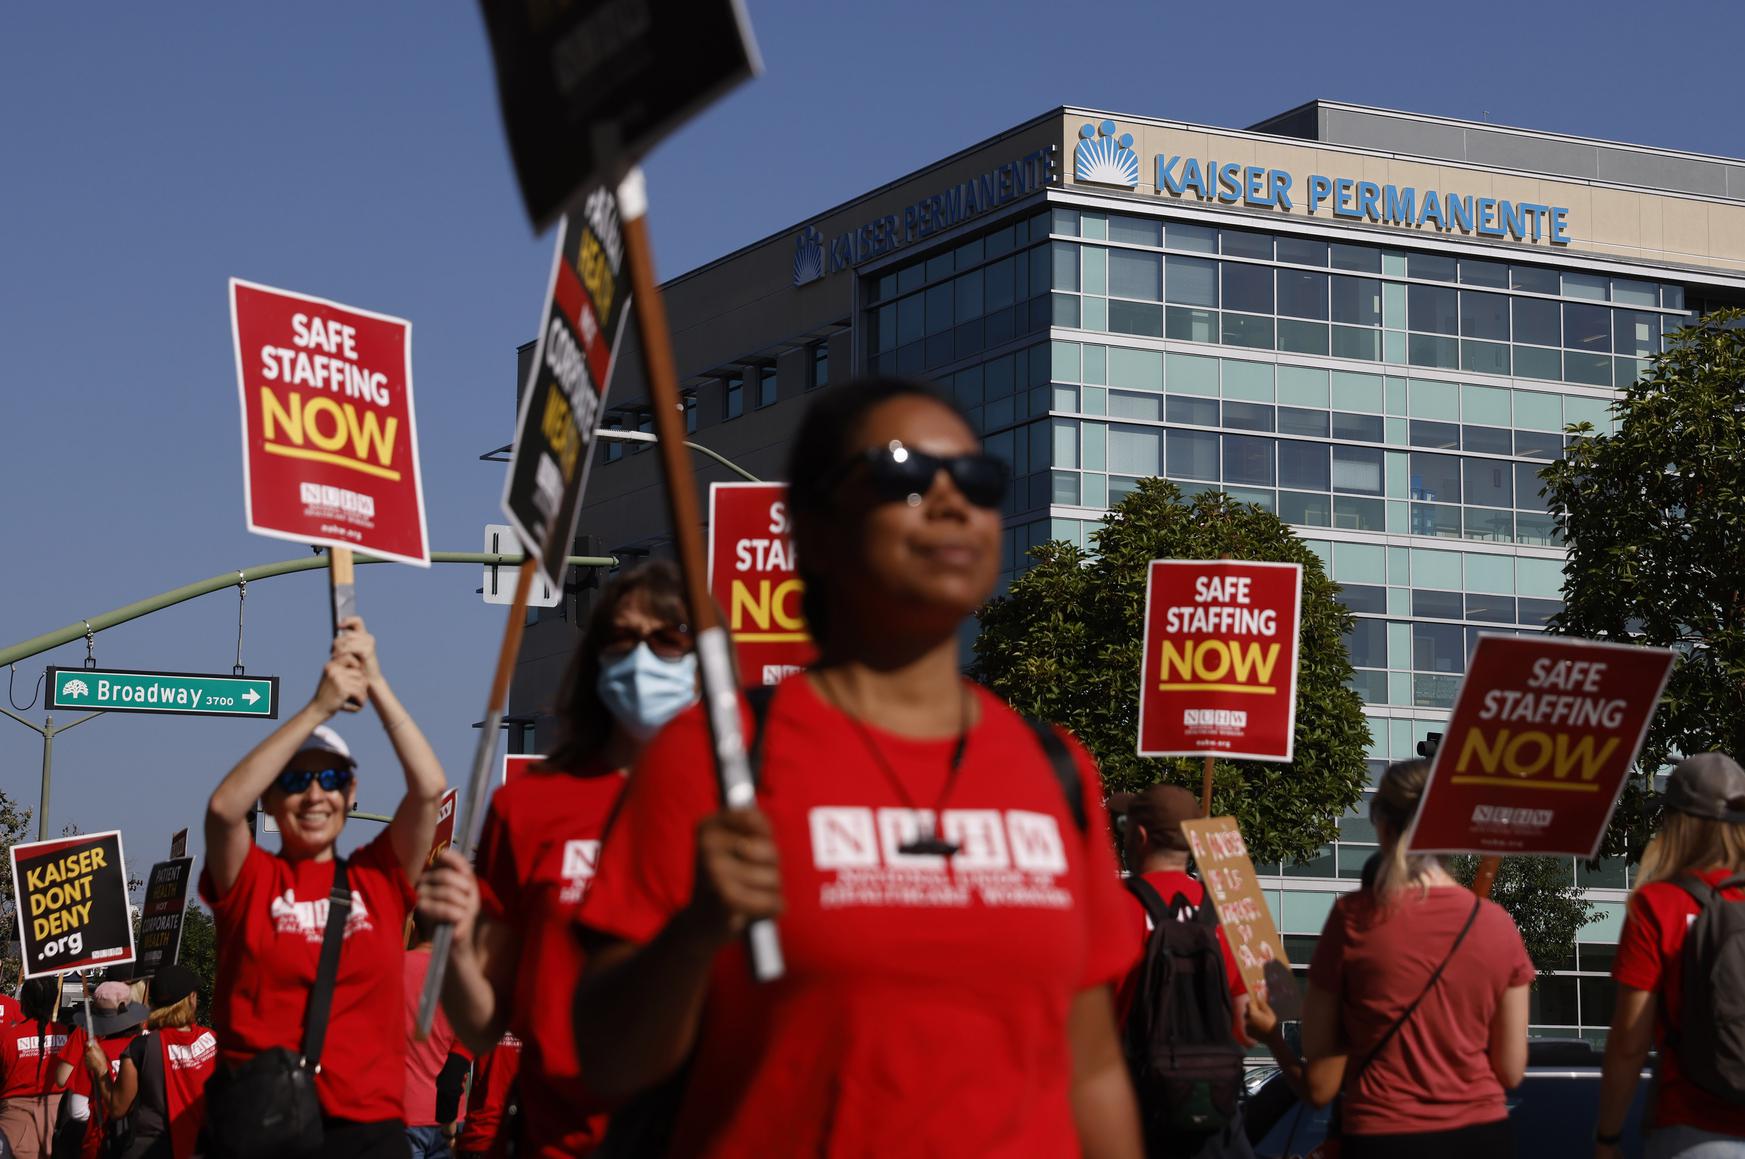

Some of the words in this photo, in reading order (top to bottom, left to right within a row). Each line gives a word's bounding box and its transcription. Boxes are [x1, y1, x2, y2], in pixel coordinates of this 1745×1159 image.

[830, 214, 898, 272] KAISER
[904, 145, 1058, 243] PERMANENTE
[1154, 153, 1293, 208] KAISER
[1308, 174, 1570, 243] PERMANENTE
[292, 312, 359, 360] SAFE
[261, 345, 390, 407] STAFFING
[261, 386, 398, 466] NOW
[1195, 576, 1251, 604] SAFE
[1166, 606, 1276, 636] STAFFING
[1160, 639, 1280, 684] NOW
[1527, 657, 1607, 692] SAFE
[98, 680, 203, 708] Broadway
[206, 696, 234, 706] 3700
[1479, 690, 1627, 729] STAFFING
[1455, 727, 1621, 781] NOW
[27, 847, 108, 892] KAISER
[30, 875, 93, 917] DONT
[33, 901, 92, 941] DENY
[38, 932, 83, 960] .org
